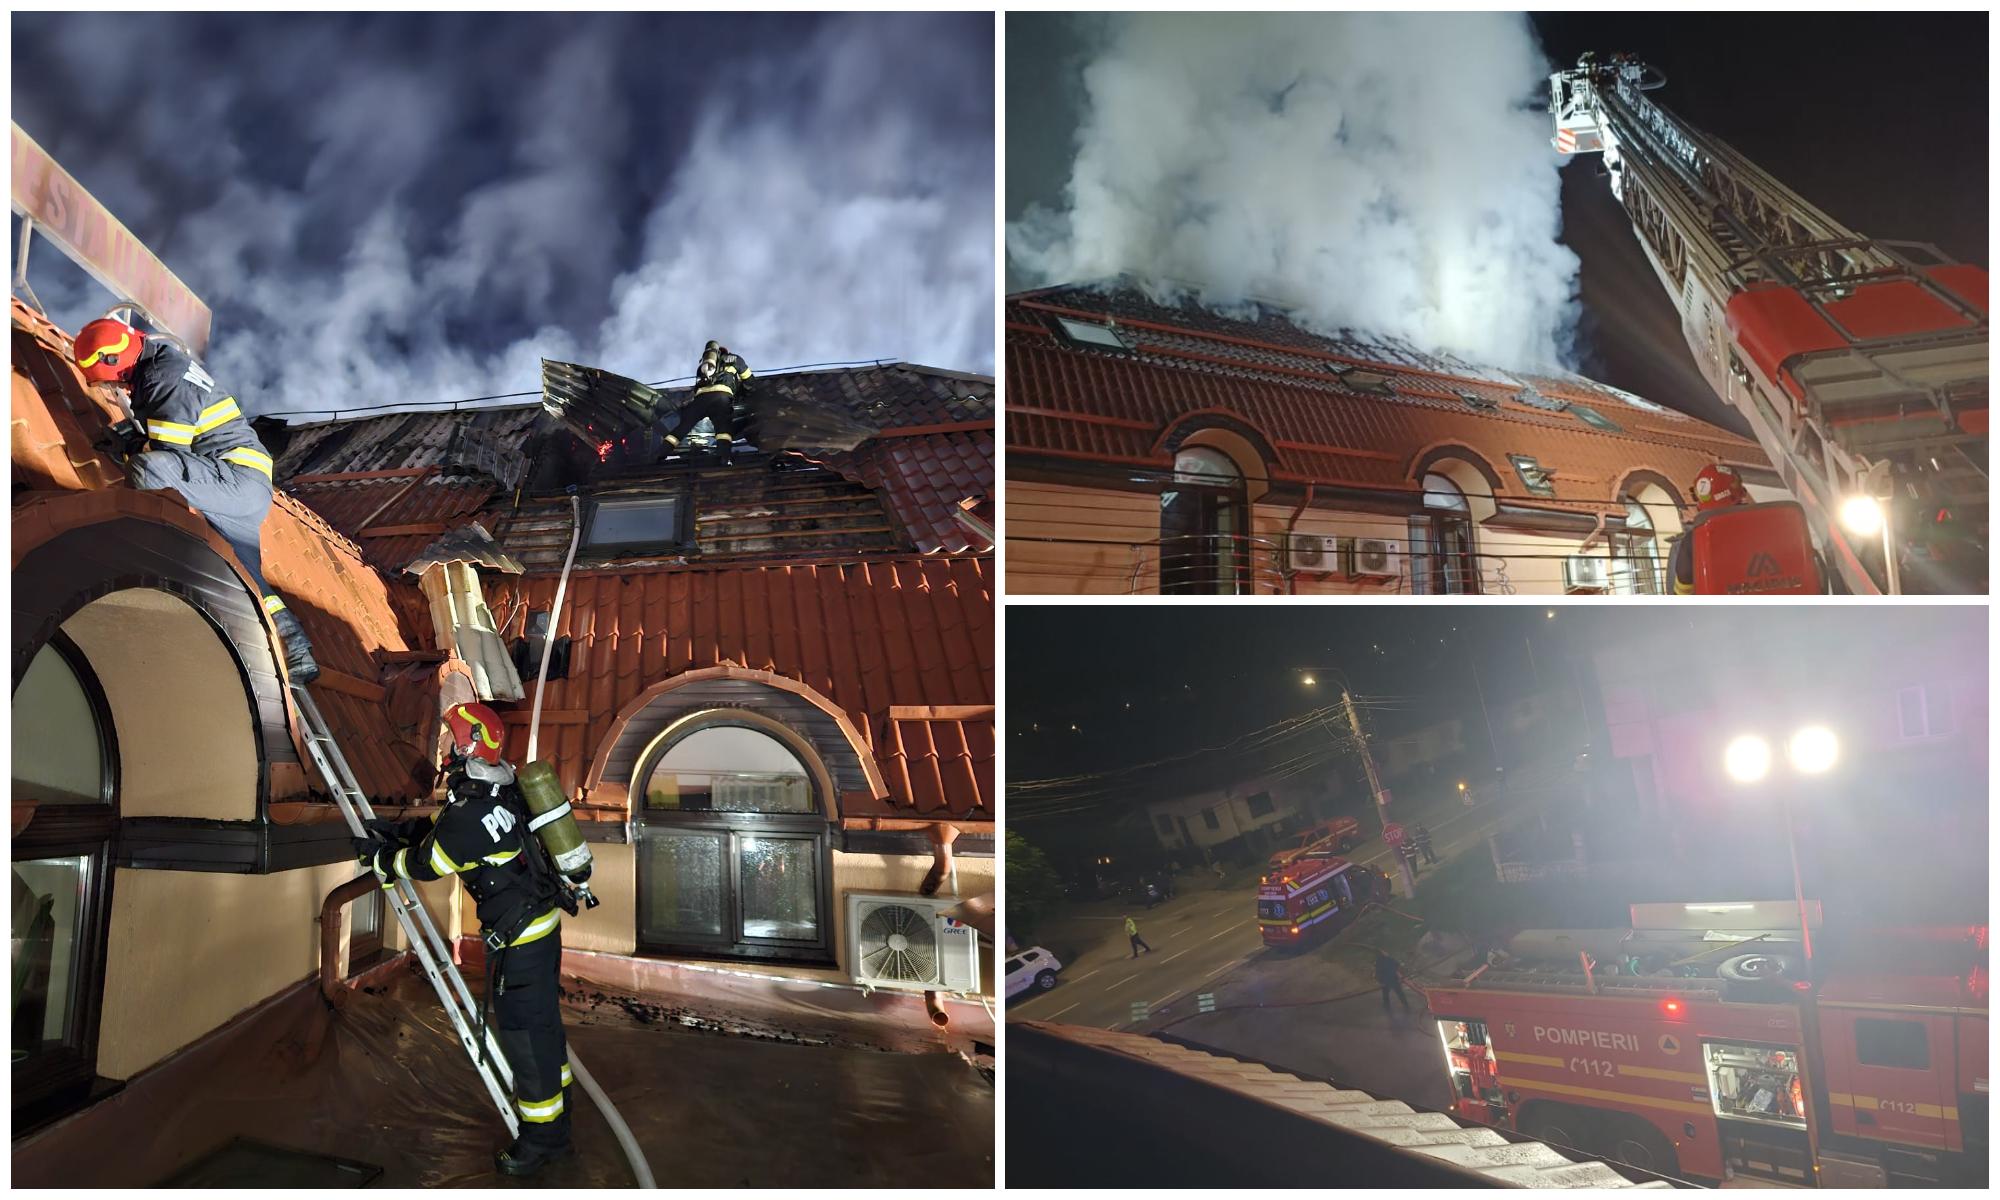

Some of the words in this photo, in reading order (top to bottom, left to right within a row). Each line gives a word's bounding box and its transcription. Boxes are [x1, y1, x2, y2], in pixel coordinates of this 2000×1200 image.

[1534, 1026, 1639, 1051] POMPIERII
[1578, 1058, 1615, 1078] 112
[1889, 1100, 1915, 1114] 112
